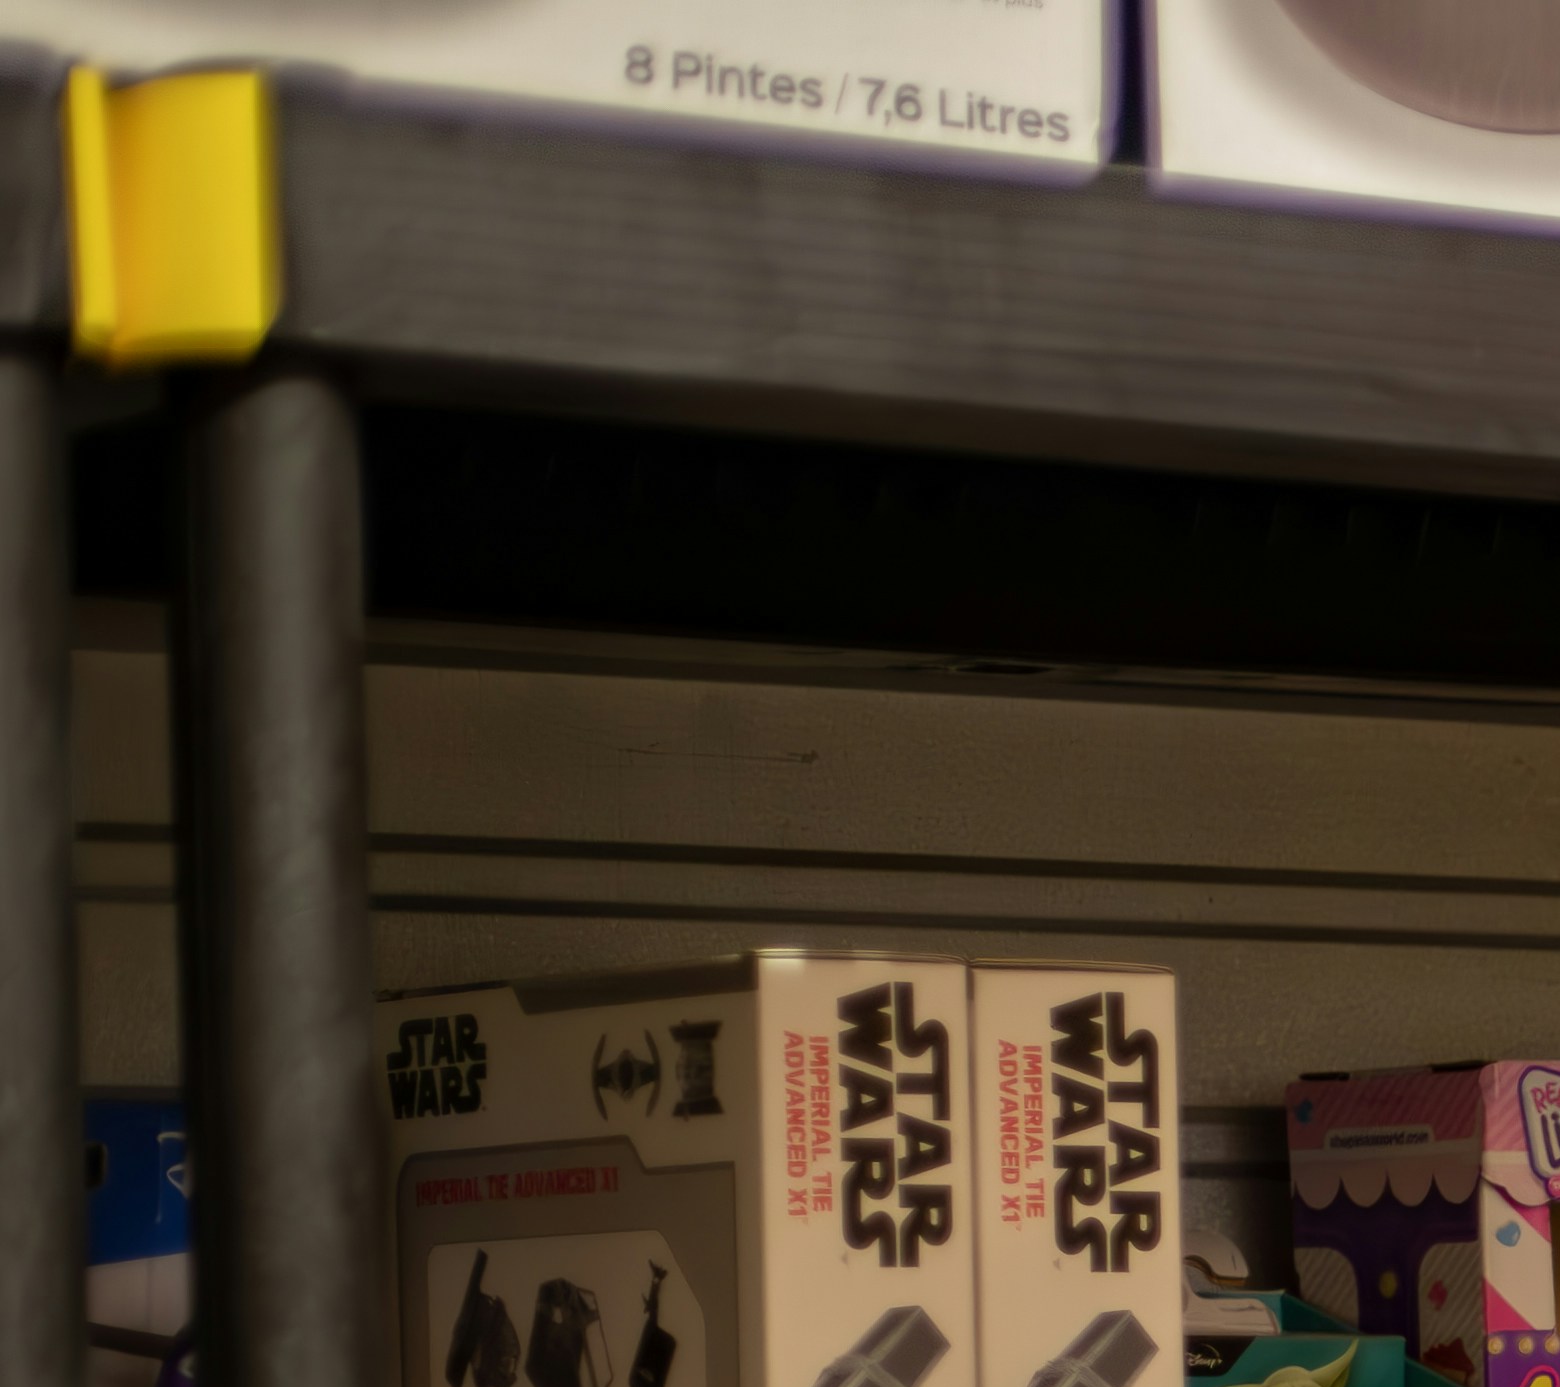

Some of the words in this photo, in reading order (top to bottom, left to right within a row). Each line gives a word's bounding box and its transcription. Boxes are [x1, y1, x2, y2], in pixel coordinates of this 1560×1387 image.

[624, 45, 657, 86] 8
[672, 51, 826, 113] Pintes
[937, 87, 1073, 143] Litres
[387, 1013, 487, 1072] STAR
[387, 1061, 487, 1120] WARS
[783, 1030, 808, 1179] ADVANCED
[808, 1034, 832, 1169] IMPERIAL
[1022, 1045, 1044, 1169] IMPERIAL
[836, 981, 898, 1268] WARS
[894, 981, 953, 1268] STAR
[998, 1039, 1020, 1184] ADVANCED
[1050, 991, 1108, 1273] WARS
[1104, 991, 1162, 1273] STAR
[811, 1171, 833, 1212] TIE
[1023, 1177, 1046, 1218] TIE
